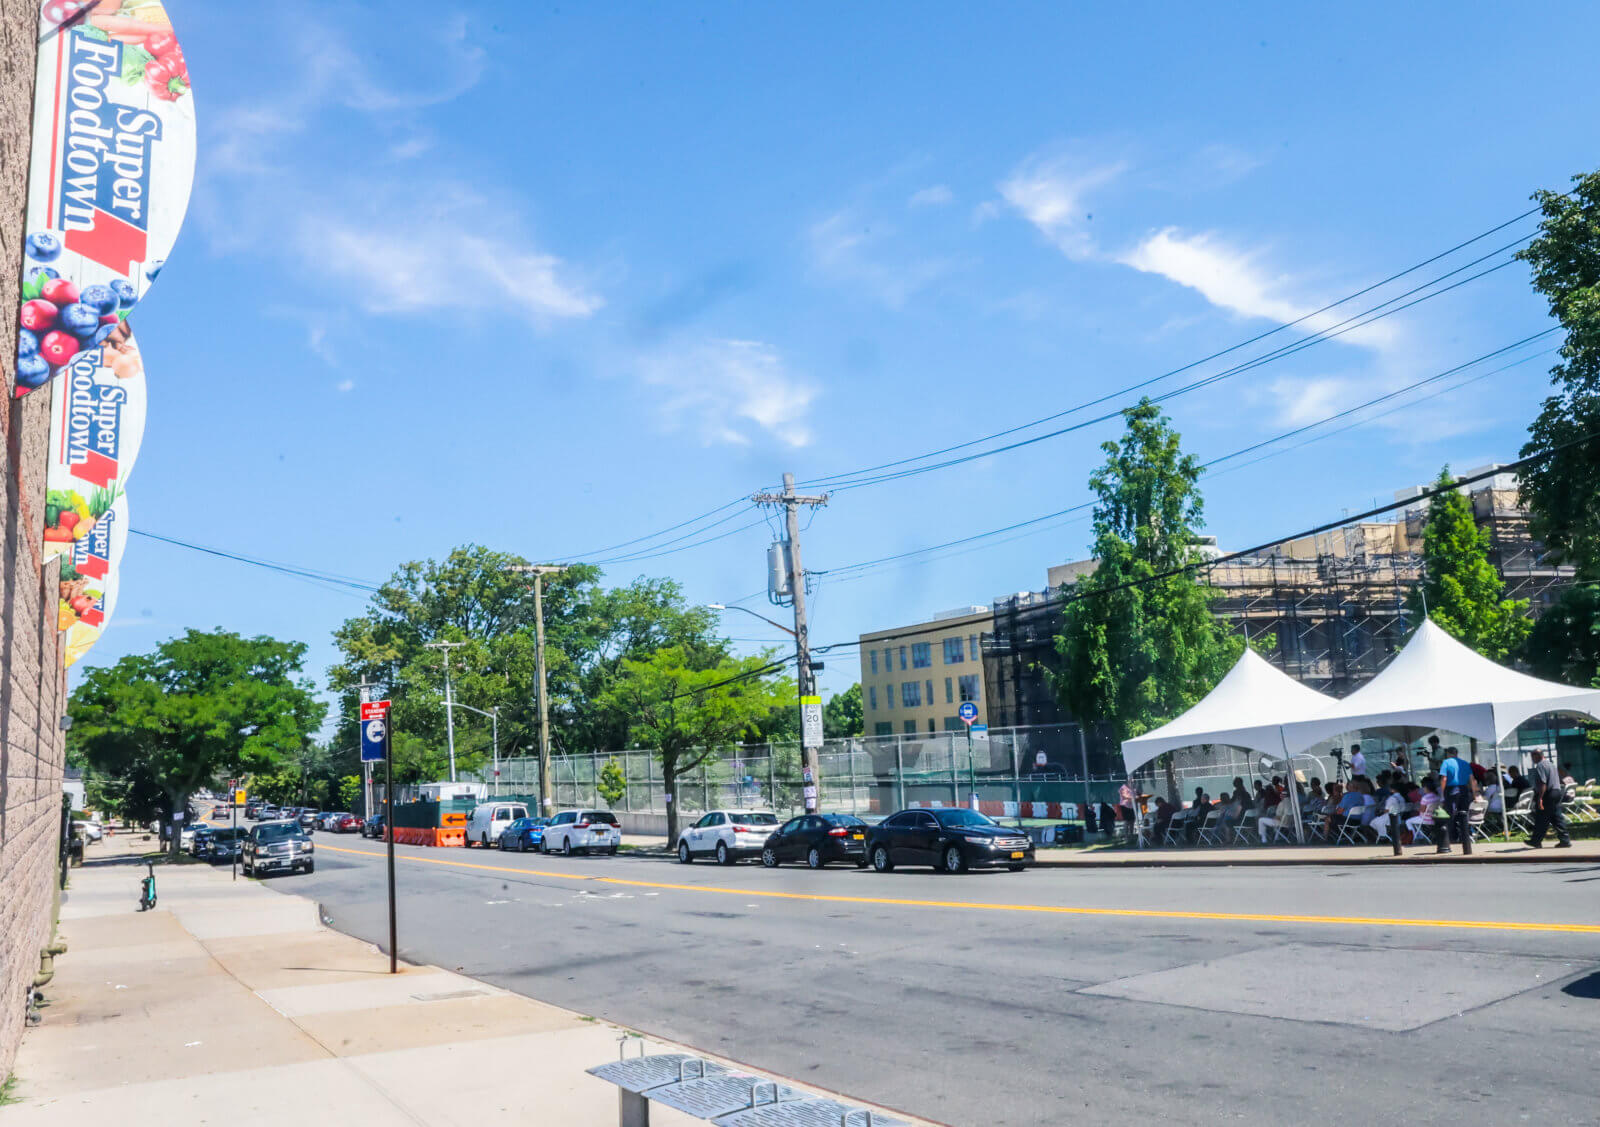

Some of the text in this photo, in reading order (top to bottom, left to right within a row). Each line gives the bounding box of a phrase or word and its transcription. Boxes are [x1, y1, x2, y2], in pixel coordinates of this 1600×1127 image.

[64, 35, 118, 232] Foodtown
[103, 107, 158, 219] Super
[70, 348, 102, 465] Foodtown
[92, 386, 125, 454] Super
[806, 714, 818, 723] 20
